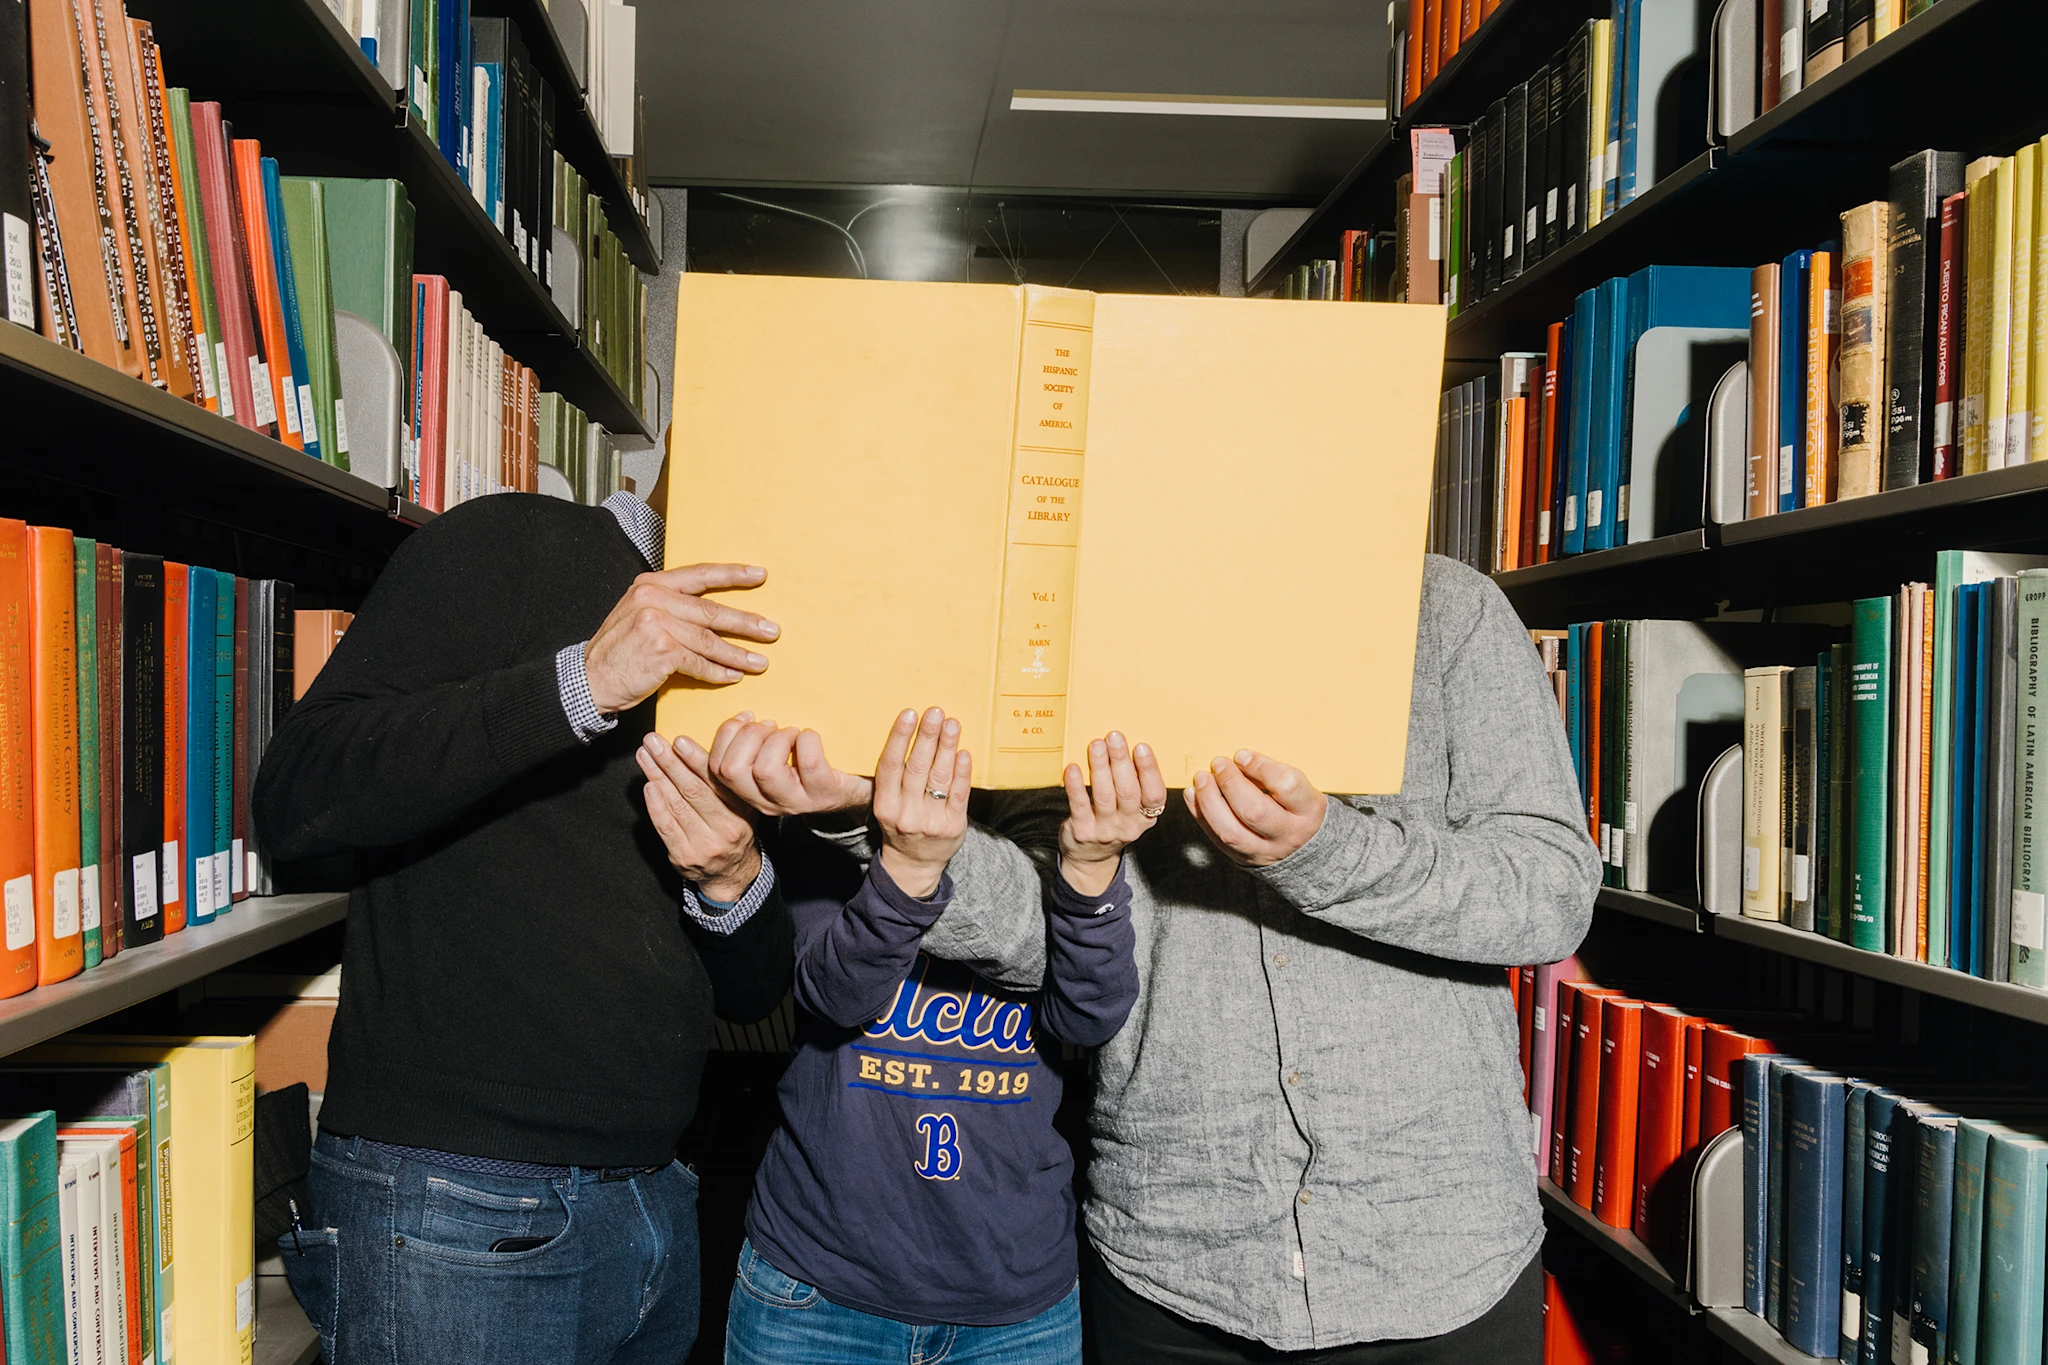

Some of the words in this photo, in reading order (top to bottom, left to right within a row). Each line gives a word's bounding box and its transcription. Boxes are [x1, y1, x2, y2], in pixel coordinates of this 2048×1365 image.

[141, 37, 164, 167] INCORPORATING
[10, 257, 21, 268] 2013
[124, 208, 145, 302] LITERATURE
[1941, 260, 1951, 302] PUERTO
[136, 238, 160, 350] BIBLIOGRAPHY
[1940, 304, 1949, 335] RICAN
[1992, 253, 2007, 352] GRENADA
[2011, 238, 2030, 388] GUADELOUPE
[182, 291, 203, 400] BIBLIOGRAPHY
[1938, 337, 1947, 386] AUTHORS
[1967, 278, 1985, 395] BARBADOS
[1043, 366, 1078, 376] HISPANIC
[1043, 384, 1074, 393] SOCIETY
[1039, 420, 1072, 429] AMERICA
[1022, 475, 1079, 487] CATALOGUE
[1028, 511, 1070, 521] LIBRARY
[7, 602, 19, 637] The
[2025, 592, 2046, 601] GROPP
[80, 613, 90, 646] The
[143, 622, 153, 652] The
[2028, 618, 2039, 697] BIBLIOGRAPHY
[8, 644, 22, 743] Eighteenth
[61, 647, 71, 740] Eighteenth
[80, 651, 92, 740] Eighteenth
[143, 656, 153, 739] Eighteenth
[2027, 706, 2036, 718] OF
[0, 703, 11, 811] BIBLIOGRAPHY
[2026, 725, 2035, 756] LATIN
[13, 749, 24, 822] Century
[63, 747, 73, 816] Century
[84, 746, 95, 811] Century
[144, 745, 153, 806] Century
[2024, 762, 2034, 819] AMERICAN
[2022, 827, 2032, 891] BIBLIOGRAP
[859, 1055, 940, 1089] EST.
[959, 1069, 1029, 1095] 1919
[914, 1113, 962, 1180] B
[41, 1273, 51, 1307] The
[28, 1296, 42, 1362] Current
[94, 1309, 103, 1365] CONVERSATI
